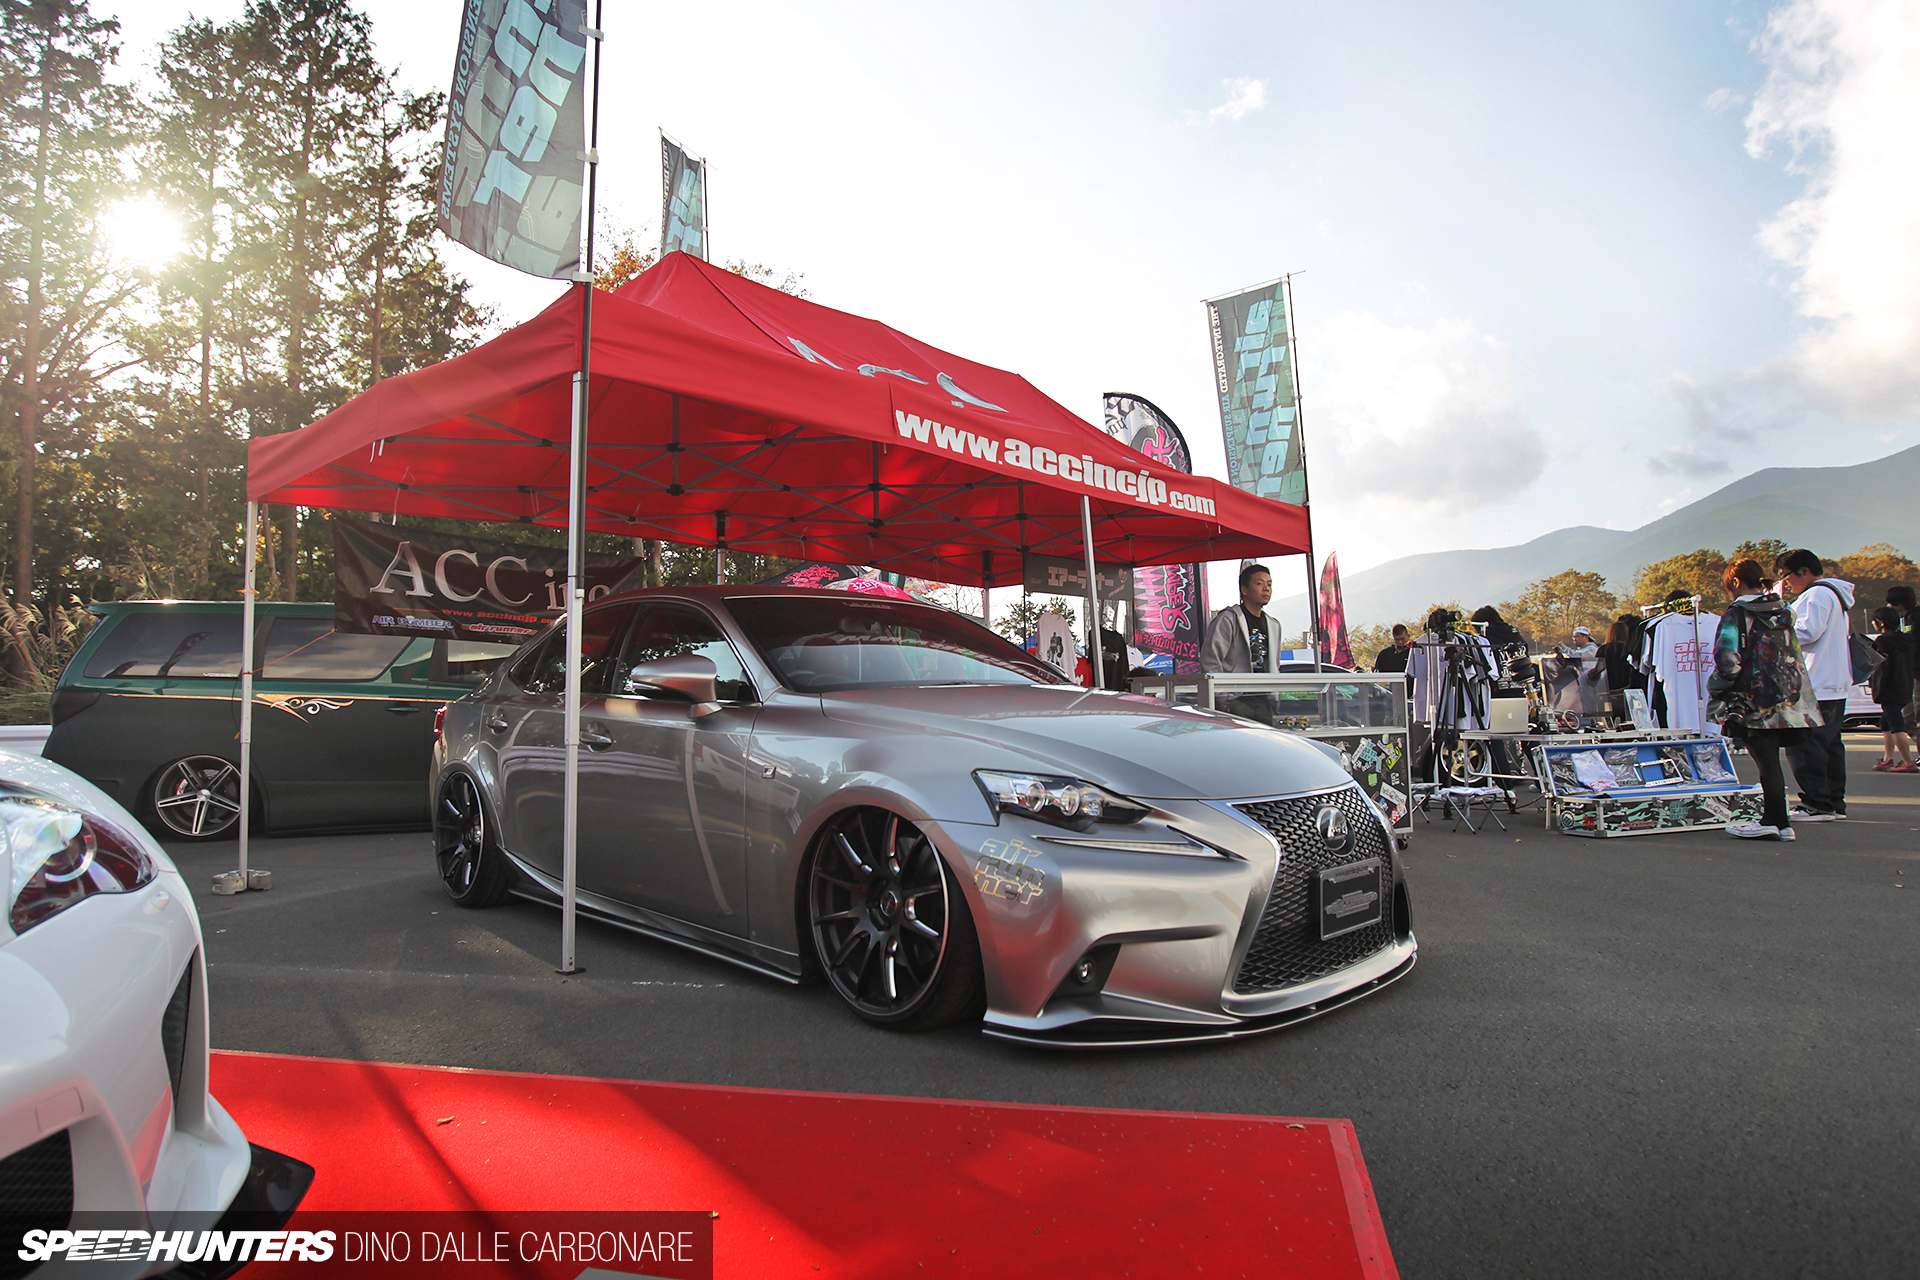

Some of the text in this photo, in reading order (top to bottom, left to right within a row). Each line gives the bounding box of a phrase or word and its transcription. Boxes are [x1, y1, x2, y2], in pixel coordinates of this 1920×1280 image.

[894, 409, 1217, 517] www.accincjp.com
[369, 540, 534, 607] ACC
[1047, 565, 1115, 591] エアーラナー
[372, 614, 395, 625] AIR
[978, 838, 1043, 866] air
[975, 855, 1046, 887] run
[973, 873, 1044, 905] ner
